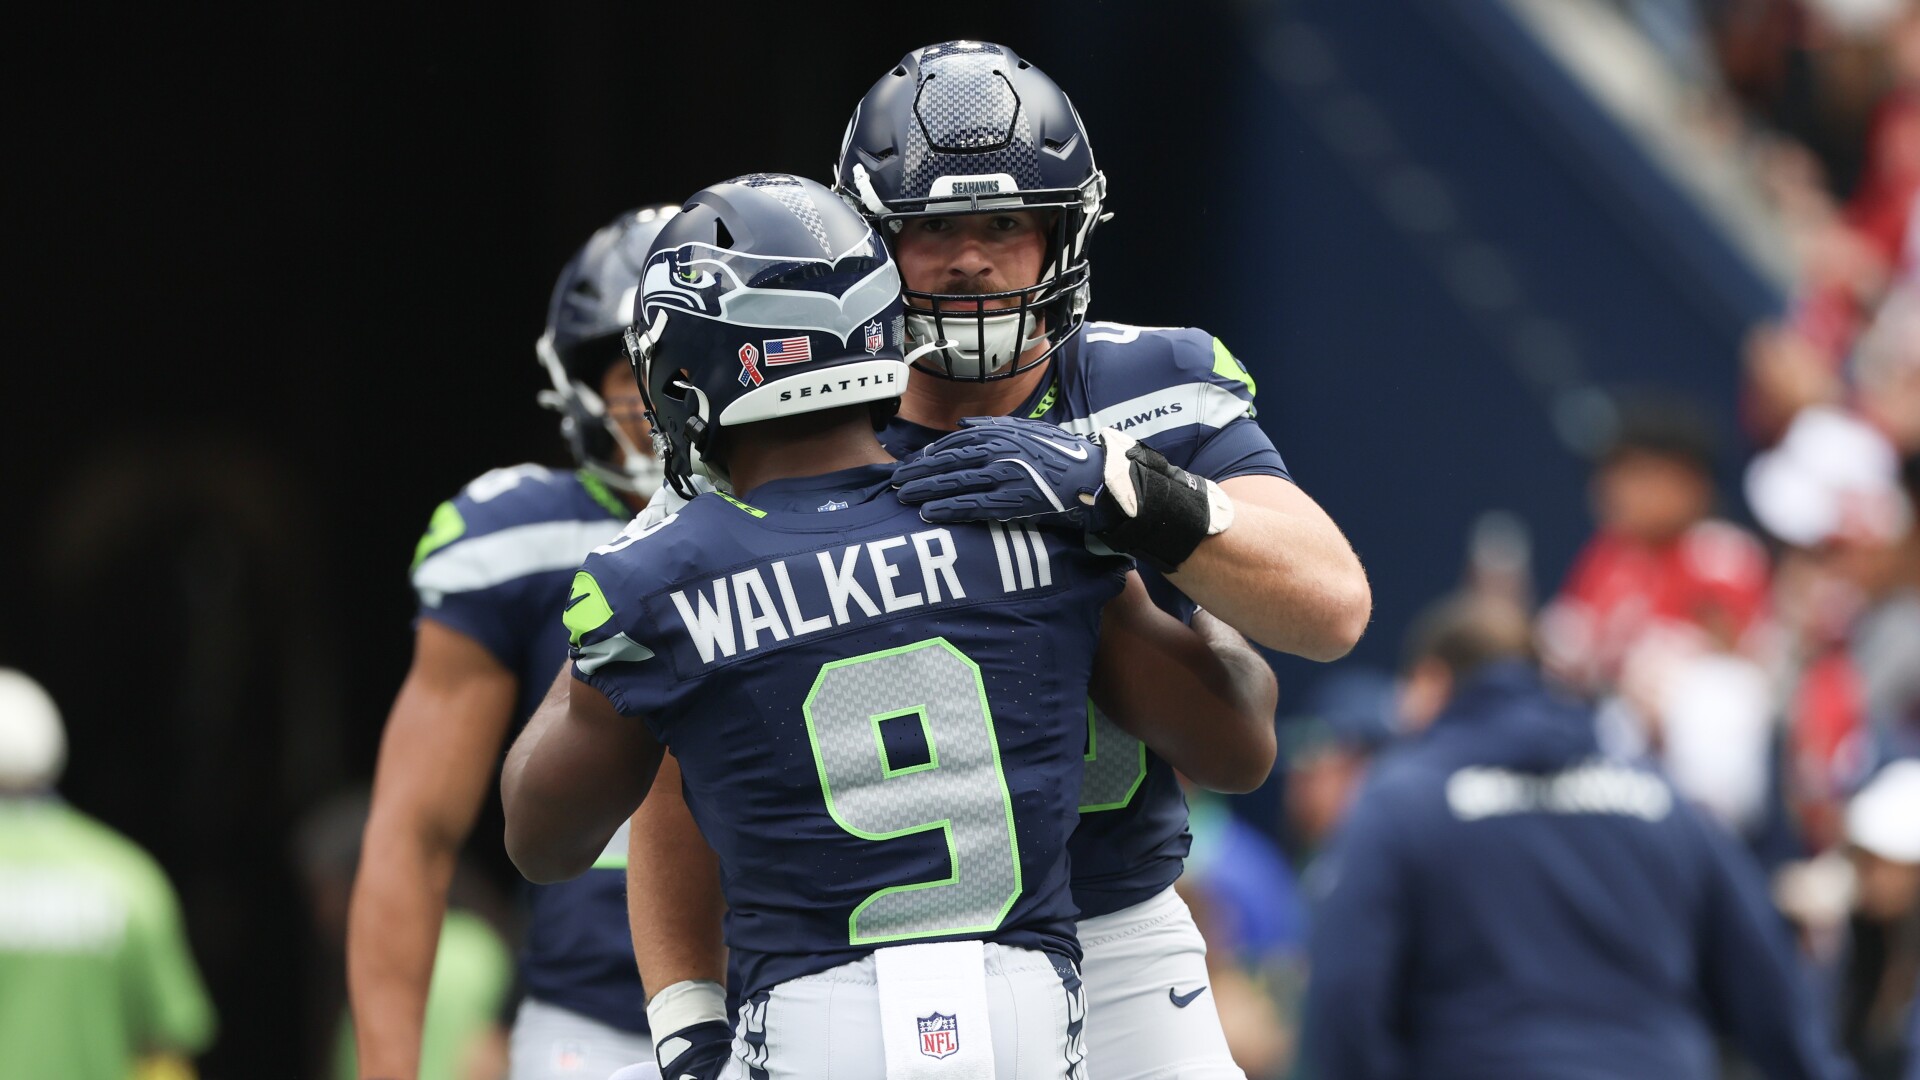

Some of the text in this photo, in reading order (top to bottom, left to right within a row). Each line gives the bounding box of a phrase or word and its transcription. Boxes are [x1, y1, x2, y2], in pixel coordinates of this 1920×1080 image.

[952, 180, 1000, 194] SEAHAWKS
[868, 336, 882, 350] NFL
[780, 373, 894, 402] SEATTLE
[1074, 402, 1183, 445] EHAWKS
[669, 520, 1053, 666] WALKER III
[802, 636, 1023, 946] 9
[923, 1031, 955, 1054] NFL
